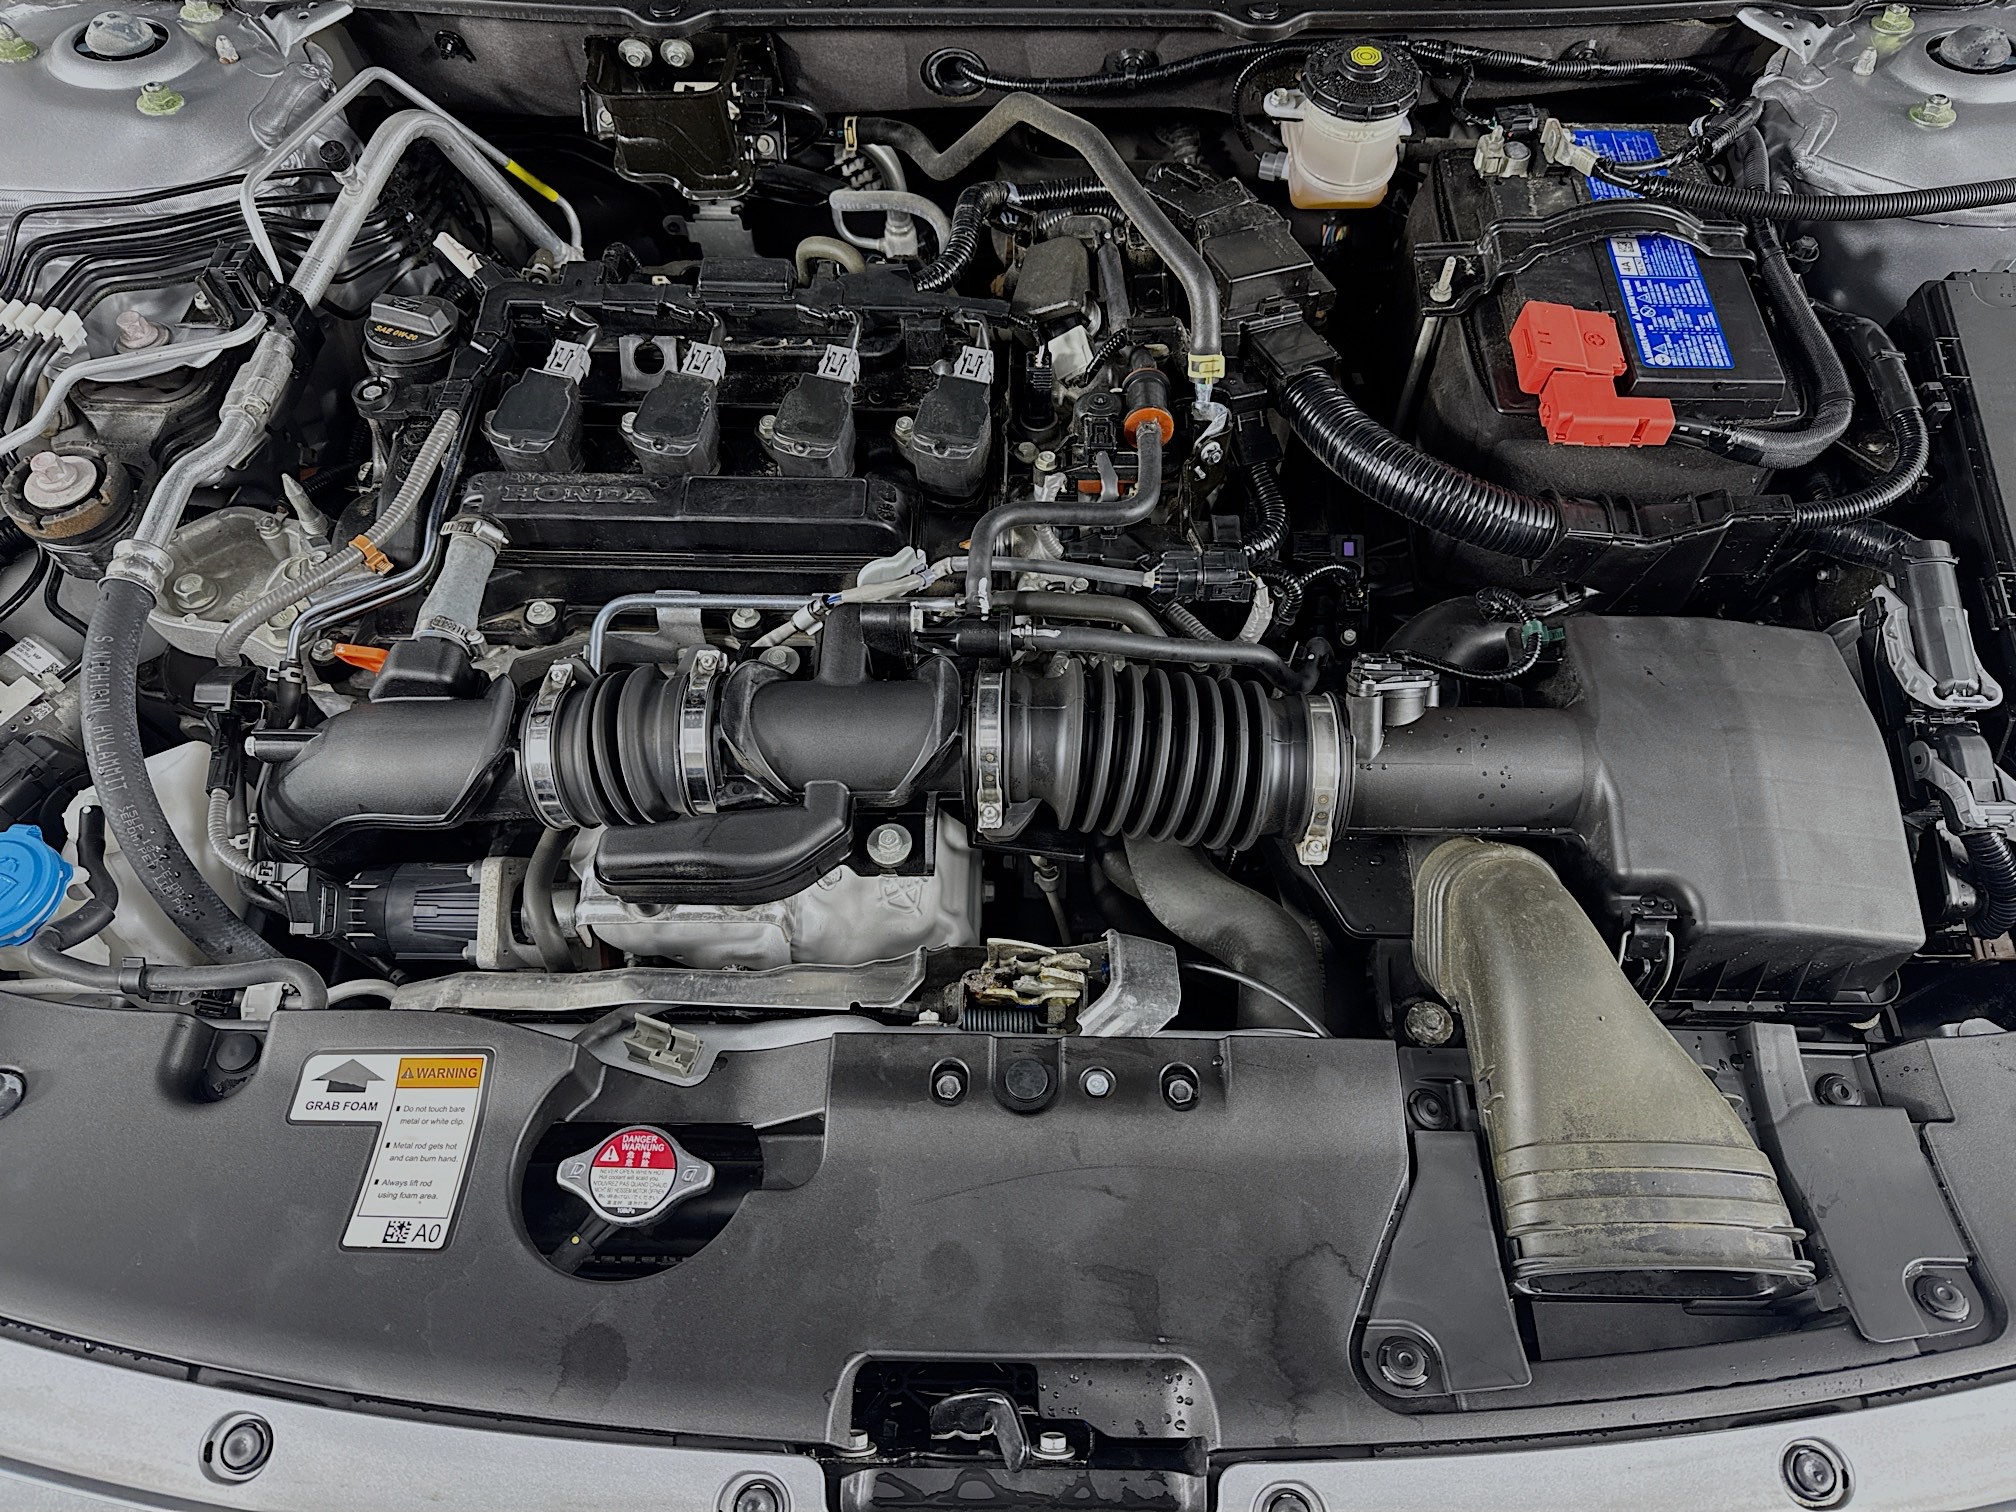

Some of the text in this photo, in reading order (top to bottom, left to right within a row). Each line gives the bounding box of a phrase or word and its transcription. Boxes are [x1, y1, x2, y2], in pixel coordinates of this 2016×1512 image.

[1621, 261, 1632, 272] 4A
[374, 325, 394, 335] SAE
[393, 329, 419, 341] 0W-20
[502, 485, 658, 503] HONDA
[416, 1067, 478, 1079] WARNING
[305, 1101, 378, 1111] GRAB FOAM
[450, 1118, 465, 1126] clip.
[623, 1135, 658, 1144] DANGER
[428, 1143, 443, 1151] gets
[622, 1143, 665, 1152] WARNUNG
[381, 1179, 408, 1188] Always
[409, 1179, 418, 1187] lift
[377, 1192, 398, 1201] using
[411, 1224, 442, 1243] A0
